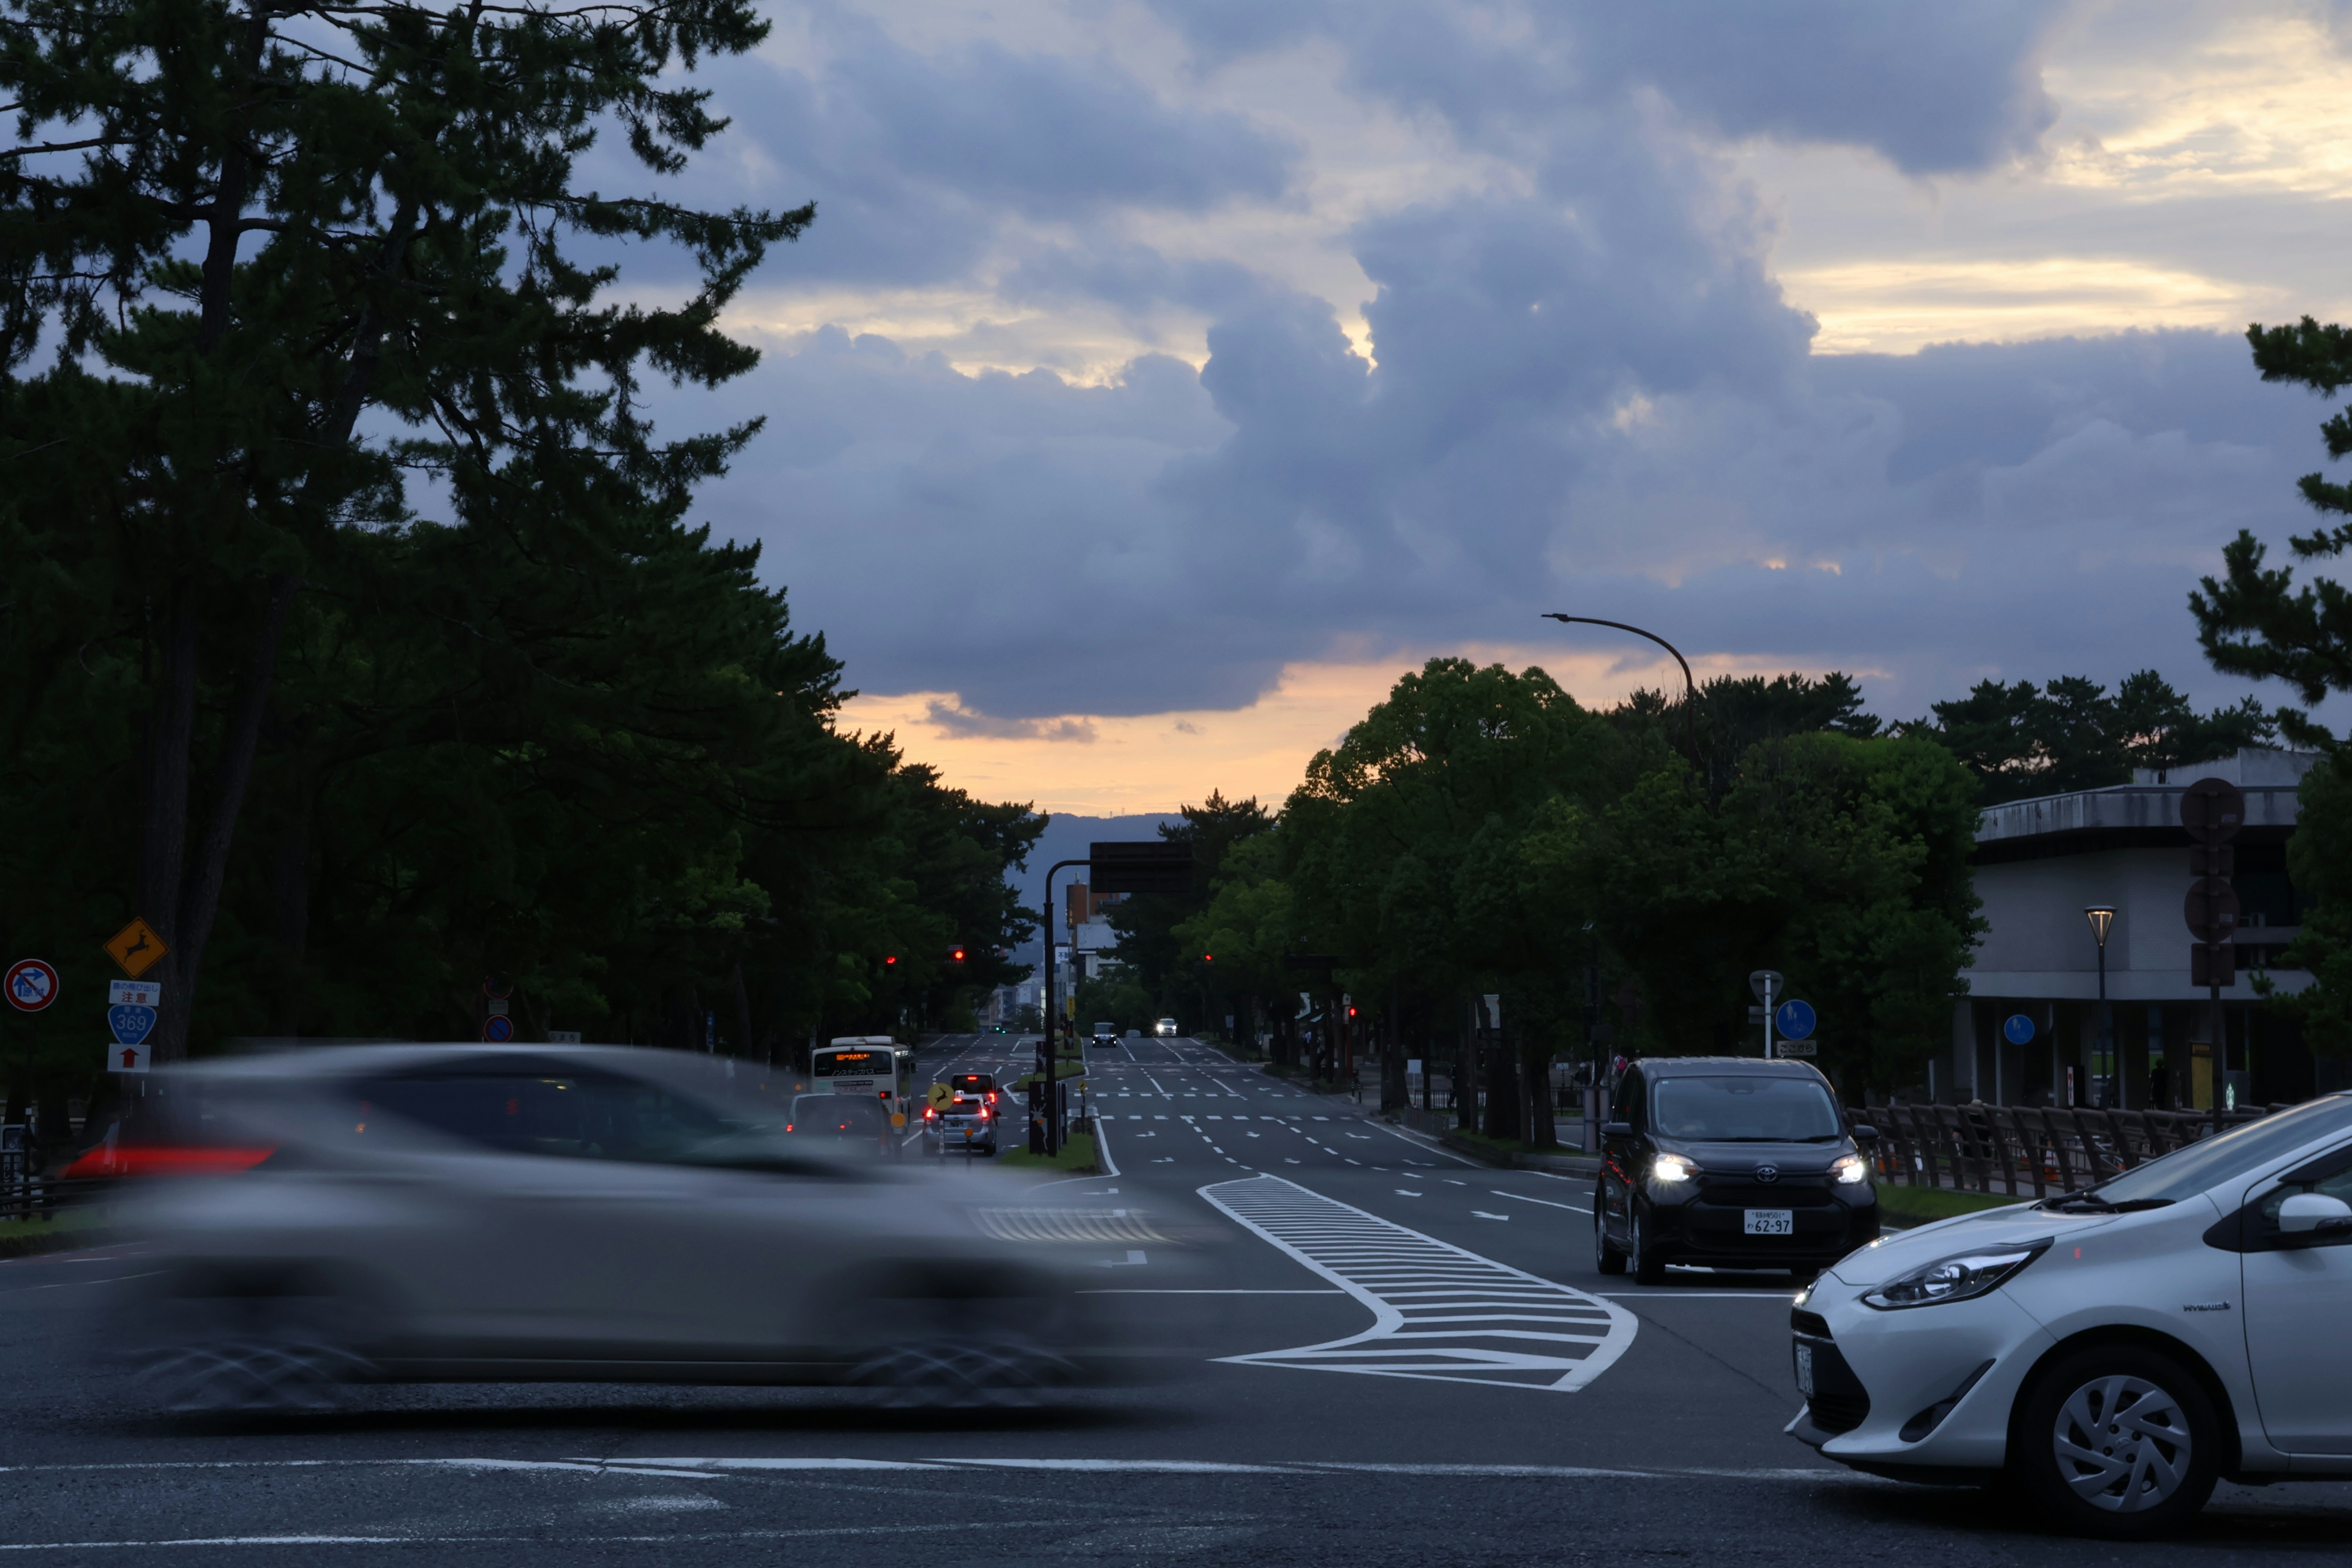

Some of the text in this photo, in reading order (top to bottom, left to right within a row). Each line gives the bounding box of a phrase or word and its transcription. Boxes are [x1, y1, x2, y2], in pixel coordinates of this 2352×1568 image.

[122, 991, 147, 1004] 注意
[116, 1014, 147, 1031] 369
[1780, 1044, 1813, 1053] ここから
[1755, 1220, 1789, 1232] 62-97
